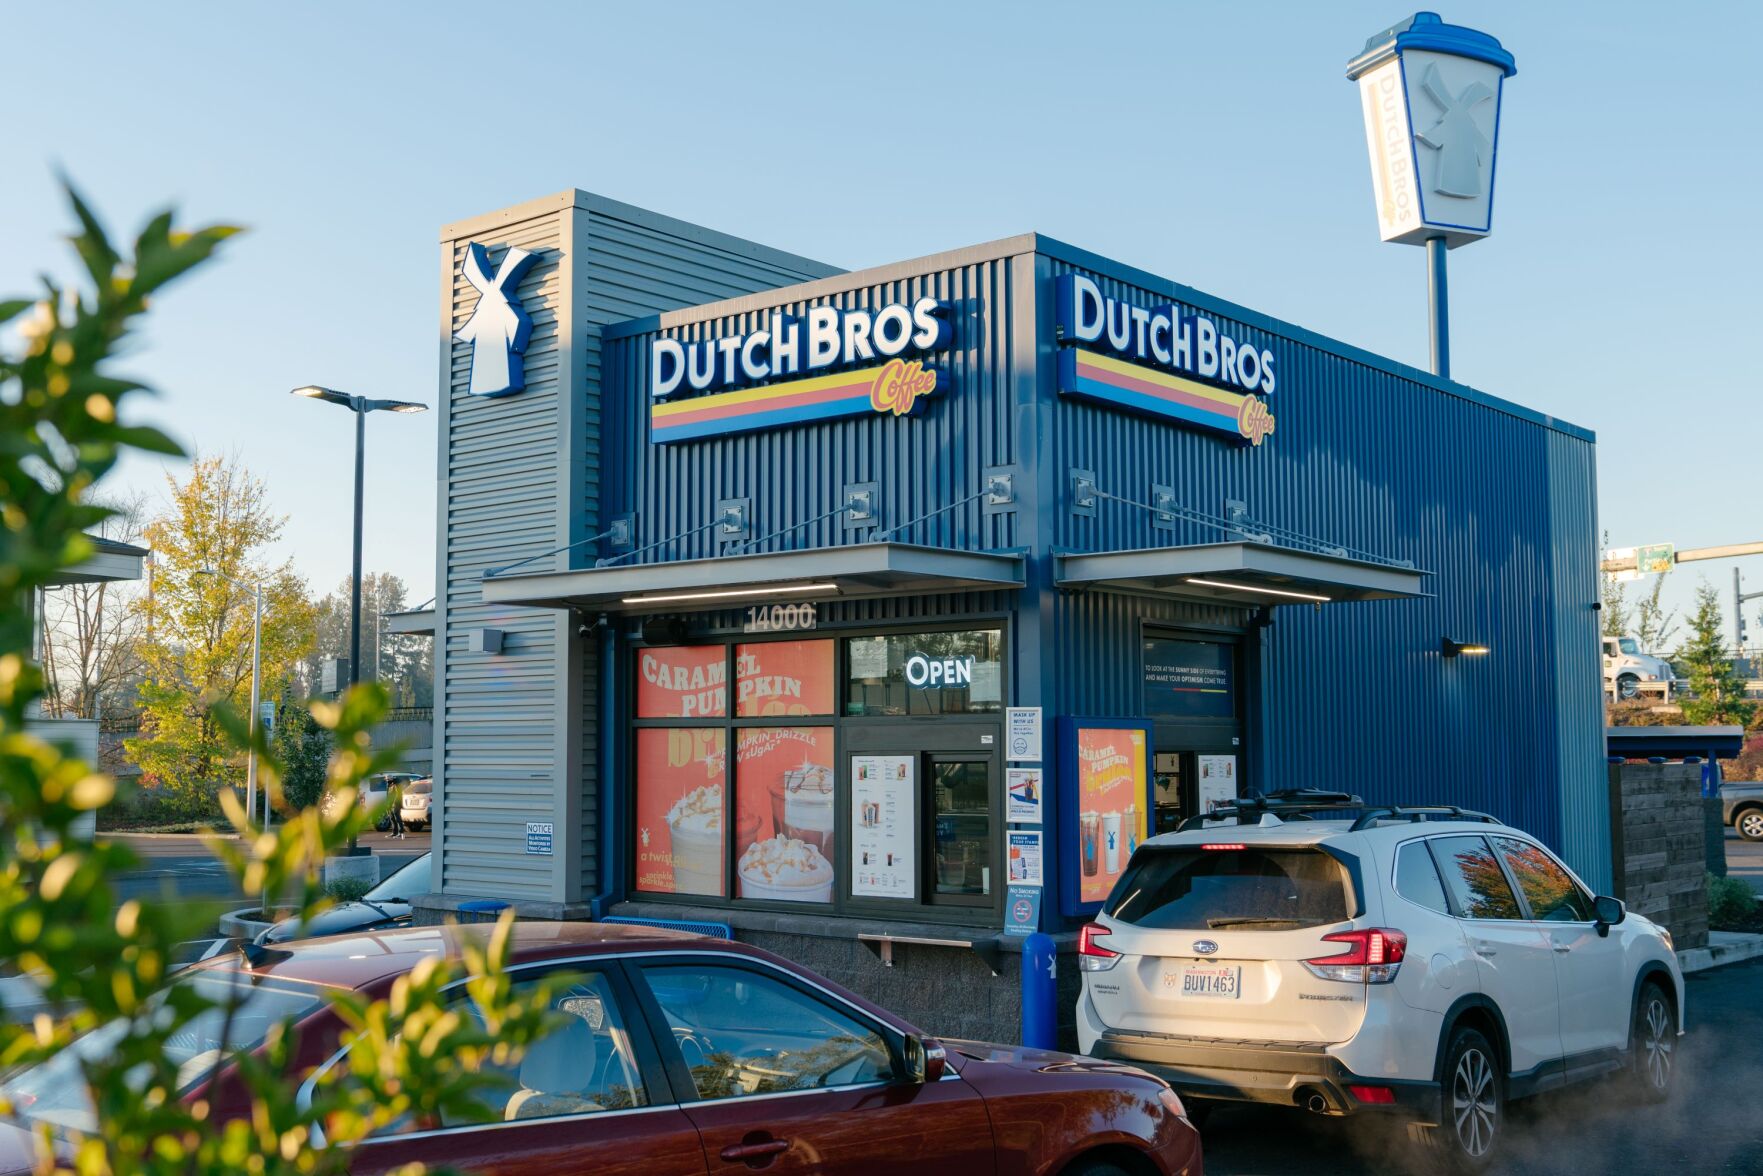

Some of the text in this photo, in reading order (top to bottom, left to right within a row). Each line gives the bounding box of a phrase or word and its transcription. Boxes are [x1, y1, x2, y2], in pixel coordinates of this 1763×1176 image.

[1380, 73, 1411, 221] DUTCH BROS
[652, 297, 940, 397] DUTCH BROS
[1074, 274, 1275, 394] DUTCH BROS
[872, 358, 936, 416] Coffee
[1238, 394, 1275, 446] Coffee
[748, 603, 813, 631] 14000
[906, 656, 971, 686] OPEN
[775, 730, 817, 747] DRIZZLE
[527, 824, 552, 834] NOTICE
[1184, 975, 1235, 993] BUV1463
